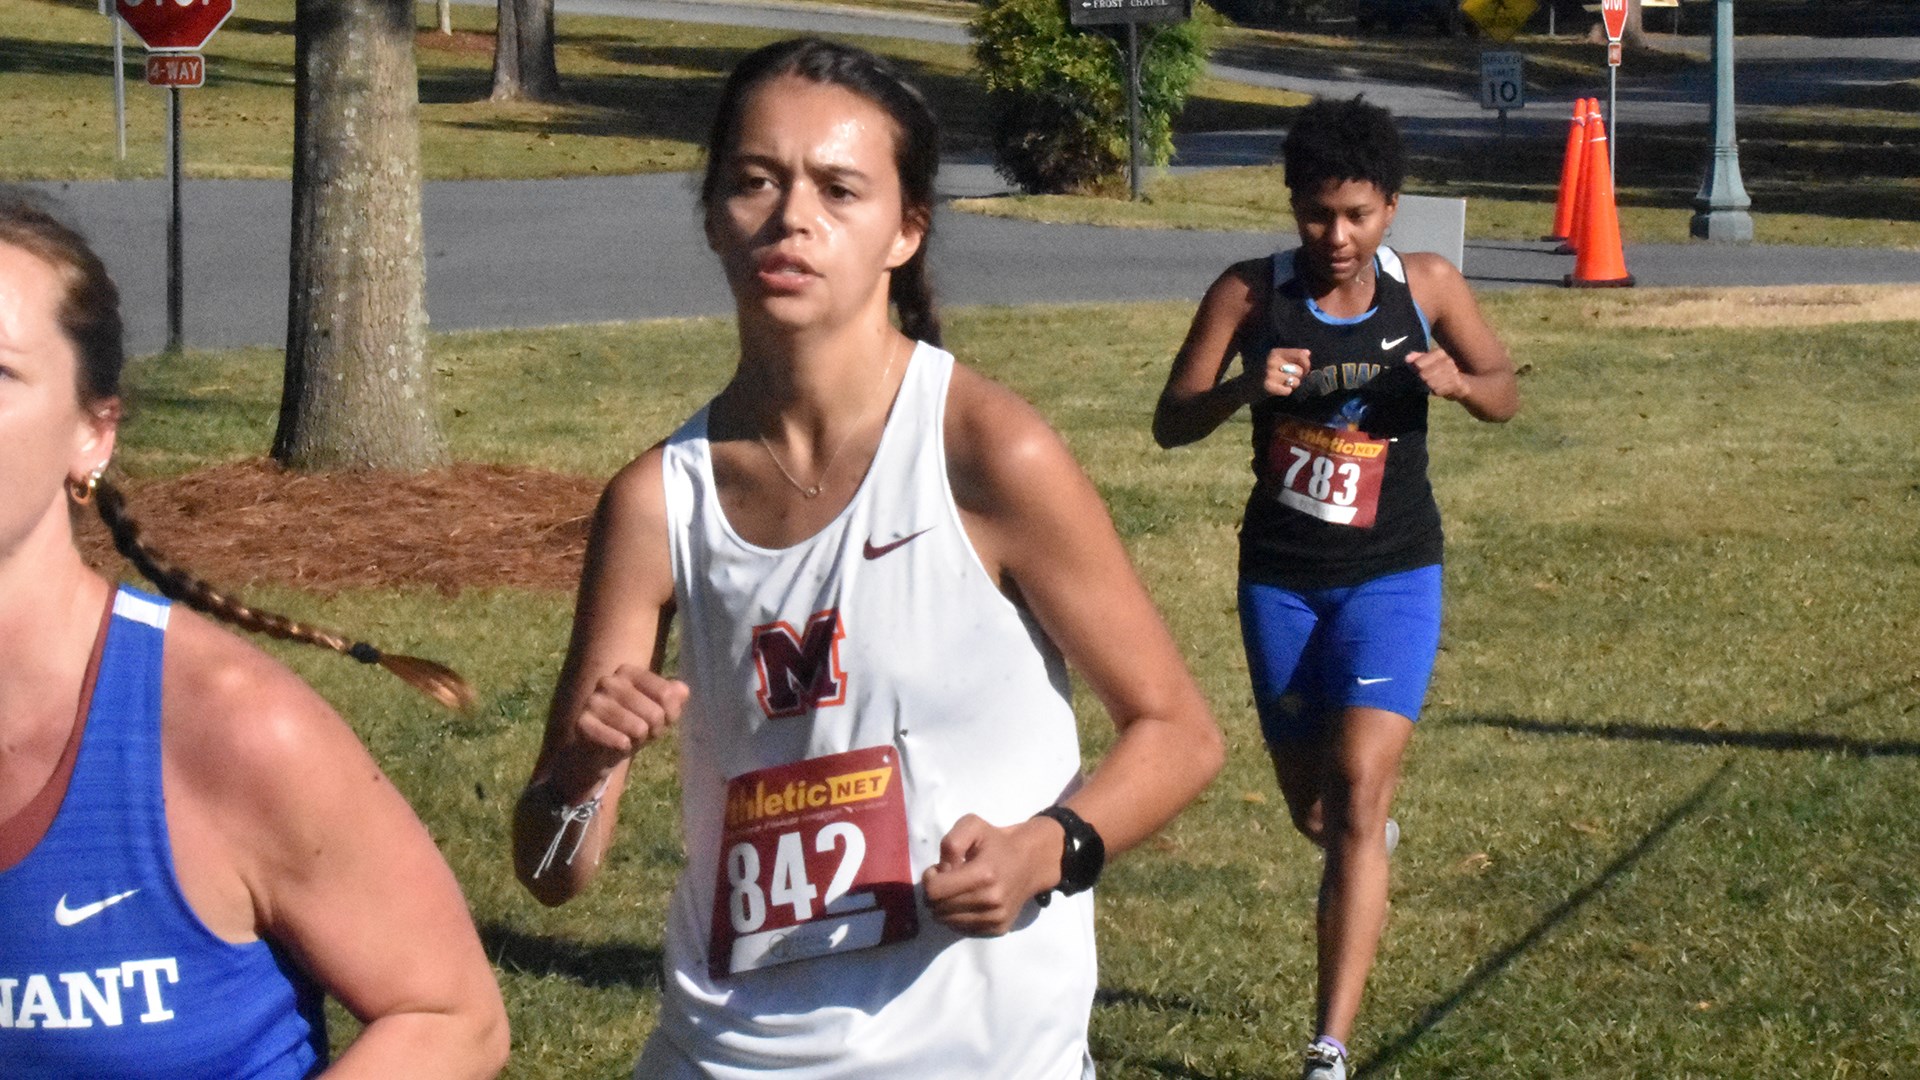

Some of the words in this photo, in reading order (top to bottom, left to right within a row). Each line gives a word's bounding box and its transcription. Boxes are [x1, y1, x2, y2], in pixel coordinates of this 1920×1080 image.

[1093, 0, 1122, 8] FROST
[150, 61, 200, 81] 4-WAY
[1489, 81, 1517, 102] 10
[1284, 446, 1361, 506] 783
[752, 609, 848, 720] M
[727, 821, 867, 934] 842
